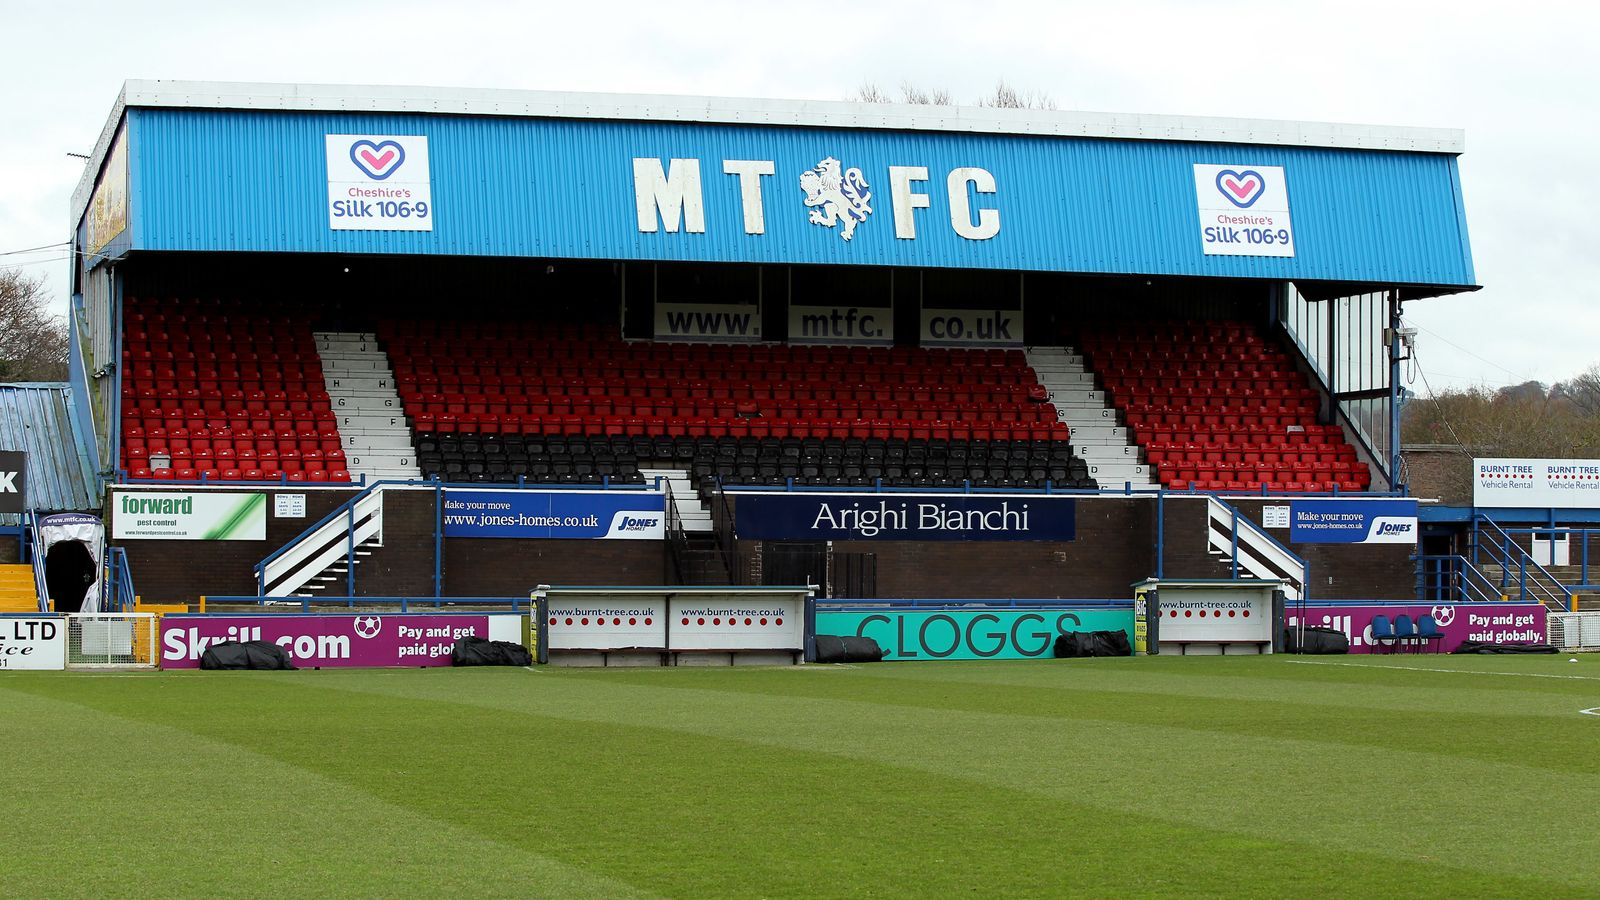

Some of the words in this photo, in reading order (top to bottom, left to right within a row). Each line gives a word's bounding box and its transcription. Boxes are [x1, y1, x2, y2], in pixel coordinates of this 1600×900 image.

[348, 187, 411, 198] Cheshire's
[332, 200, 373, 217] Silk
[1217, 214, 1273, 225] Cheshire's
[1204, 226, 1241, 243] Silk
[333, 379, 340, 387] H
[378, 380, 386, 388] H
[338, 398, 345, 406] G
[384, 399, 392, 407] G
[1057, 409, 1065, 417] G
[1102, 410, 1109, 418] G
[390, 418, 397, 426] F
[1070, 428, 1076, 436] F
[1112, 428, 1118, 436] F
[349, 436, 355, 445] E
[1081, 446, 1087, 454] E
[353, 457, 360, 465] D
[400, 458, 408, 466] D
[1091, 466, 1098, 474] D
[1135, 466, 1142, 474] D
[1480, 465, 1510, 473] BURNT
[1512, 465, 1533, 473] TREE
[1547, 466, 1577, 474] BURNT
[1578, 466, 1599, 474] TREE
[1481, 480, 1508, 489] Vehicle
[1508, 480, 1534, 489] Rental
[1548, 481, 1575, 490] Vehicle
[1575, 481, 1600, 490] Rental
[121, 495, 192, 515] forward
[466, 502, 486, 510] your
[487, 502, 511, 510] move
[46, 516, 96, 524] www.mtfc.co.uk
[444, 512, 599, 527] www.jones-homes.co.uk
[811, 500, 908, 537] Arighi
[917, 501, 1029, 531] Bianchi
[1297, 511, 1319, 521] Make
[1320, 513, 1340, 522] your
[137, 519, 151, 527] pest
[152, 519, 177, 527] control
[618, 516, 659, 531] JONES
[1297, 522, 1364, 530] www.jones-homes.co.uk
[1375, 521, 1412, 535] JONES
[548, 607, 654, 617] www.burnt-tree.co.uk
[680, 607, 785, 617] www.burnt-tree.co.uk
[1469, 613, 1490, 627] Pay
[1492, 613, 1513, 625] and
[1515, 613, 1534, 627] get
[14, 621, 57, 641] LTD
[398, 625, 423, 640] Pay
[425, 625, 451, 638] and
[453, 625, 476, 640] get
[1469, 630, 1494, 642] paid
[1495, 629, 1543, 644] globally.
[163, 626, 350, 660] Skcom
[398, 642, 427, 658] paid
